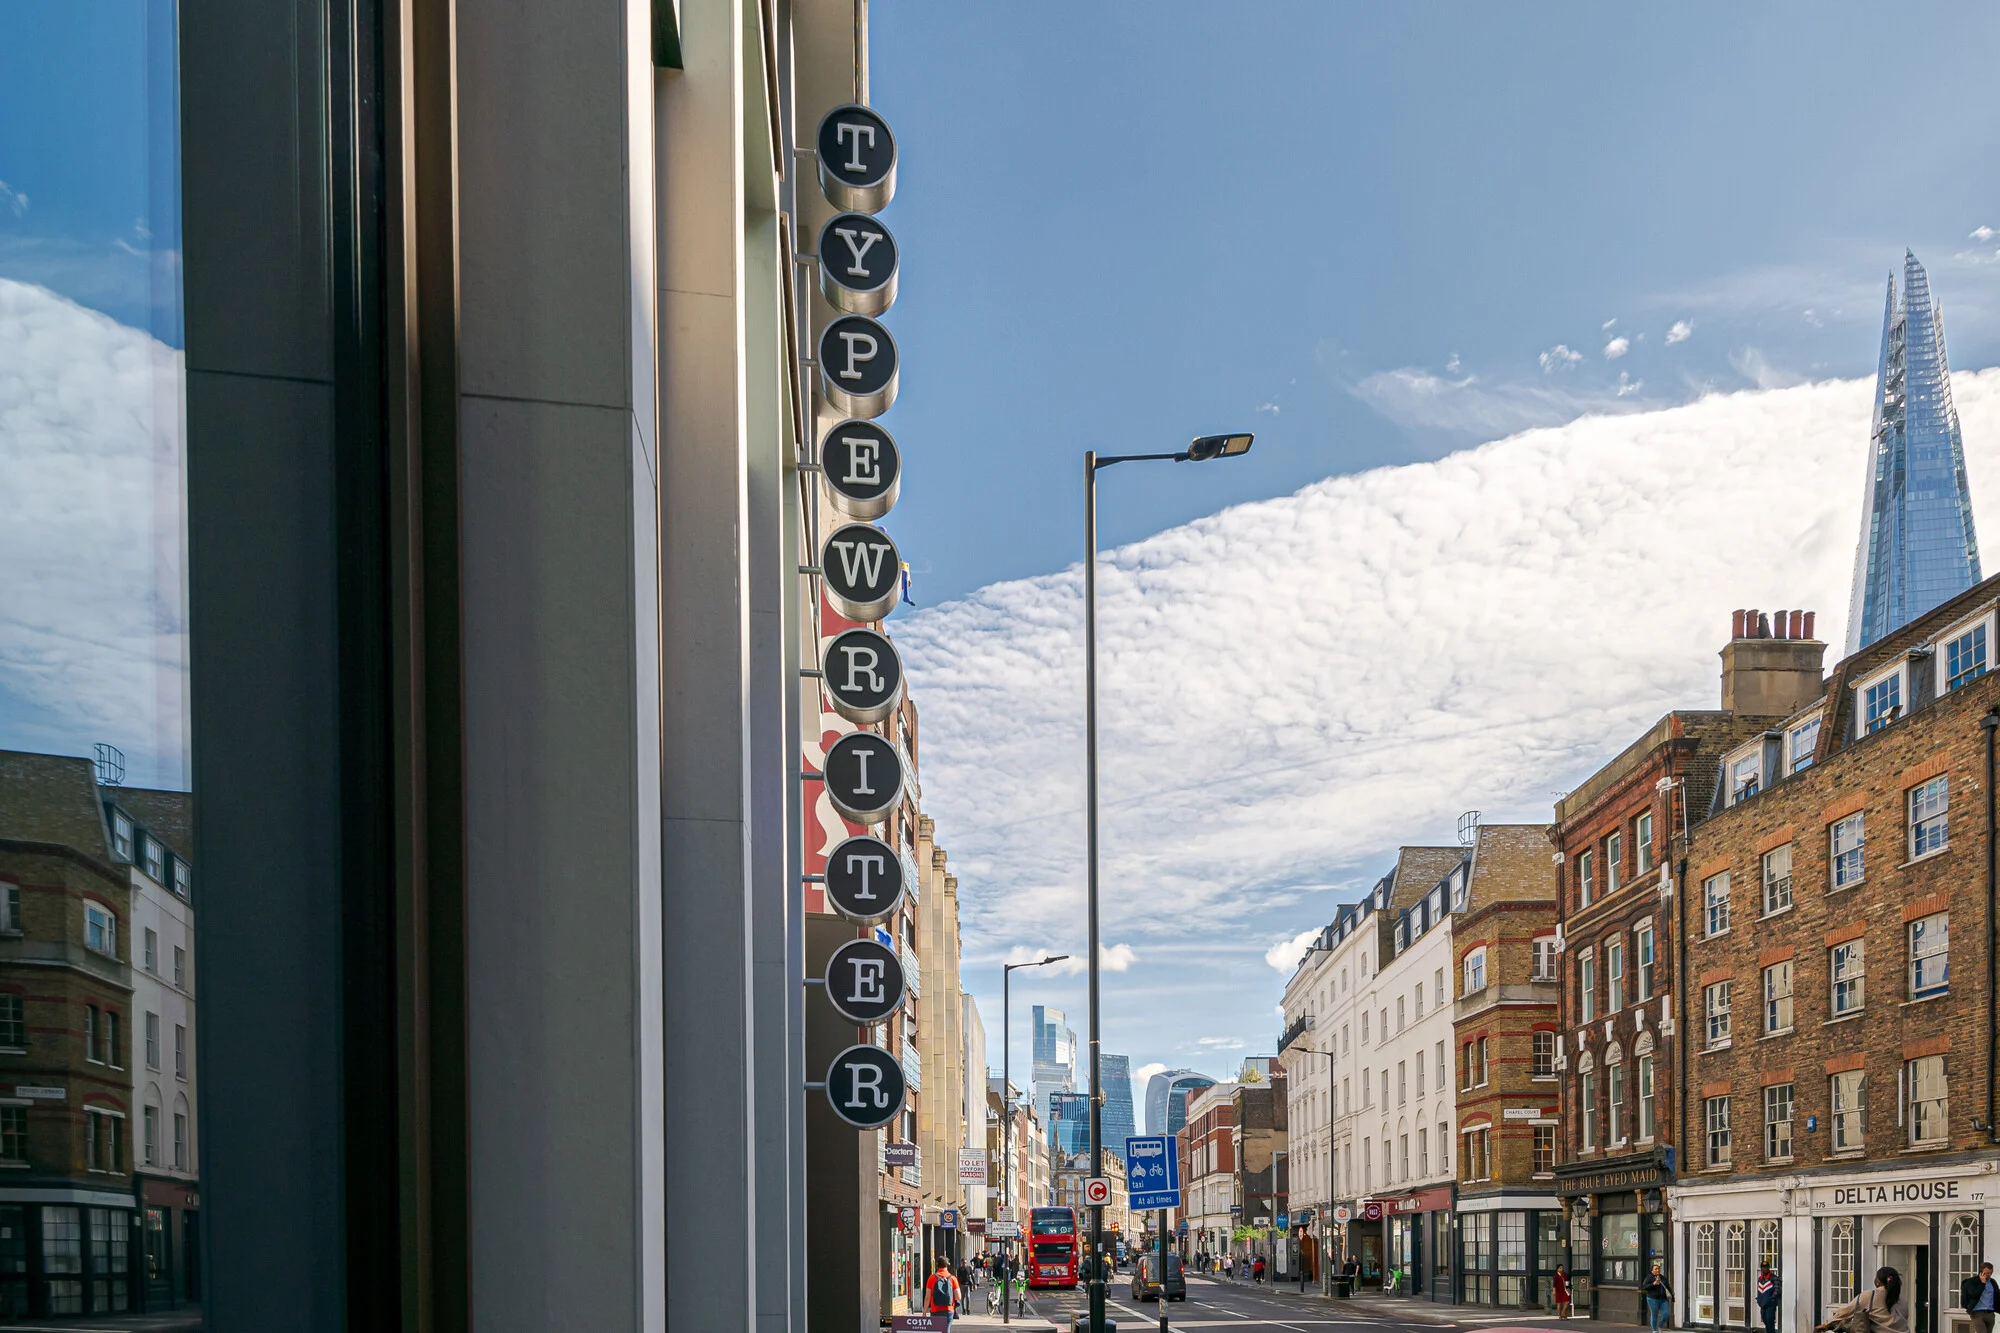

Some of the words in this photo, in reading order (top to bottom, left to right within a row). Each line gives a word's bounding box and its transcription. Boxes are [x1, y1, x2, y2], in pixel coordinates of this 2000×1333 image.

[832, 123, 891, 1109] TYPEWRITER
[887, 1147, 914, 1156] Dexters
[1132, 1180, 1144, 1188] taxi
[1560, 1178, 1576, 1192] THE
[1579, 1175, 1601, 1190] BLUE
[1604, 1172, 1627, 1187] EYED
[1631, 1168, 1657, 1183] MAID
[1834, 1186, 1887, 1205] DELTA
[1893, 1181, 1959, 1202] HOUSE
[1971, 1193, 1984, 1201] 177
[1138, 1197, 1145, 1205] At
[1156, 1195, 1172, 1204] times
[906, 1318, 932, 1326] COSTA
